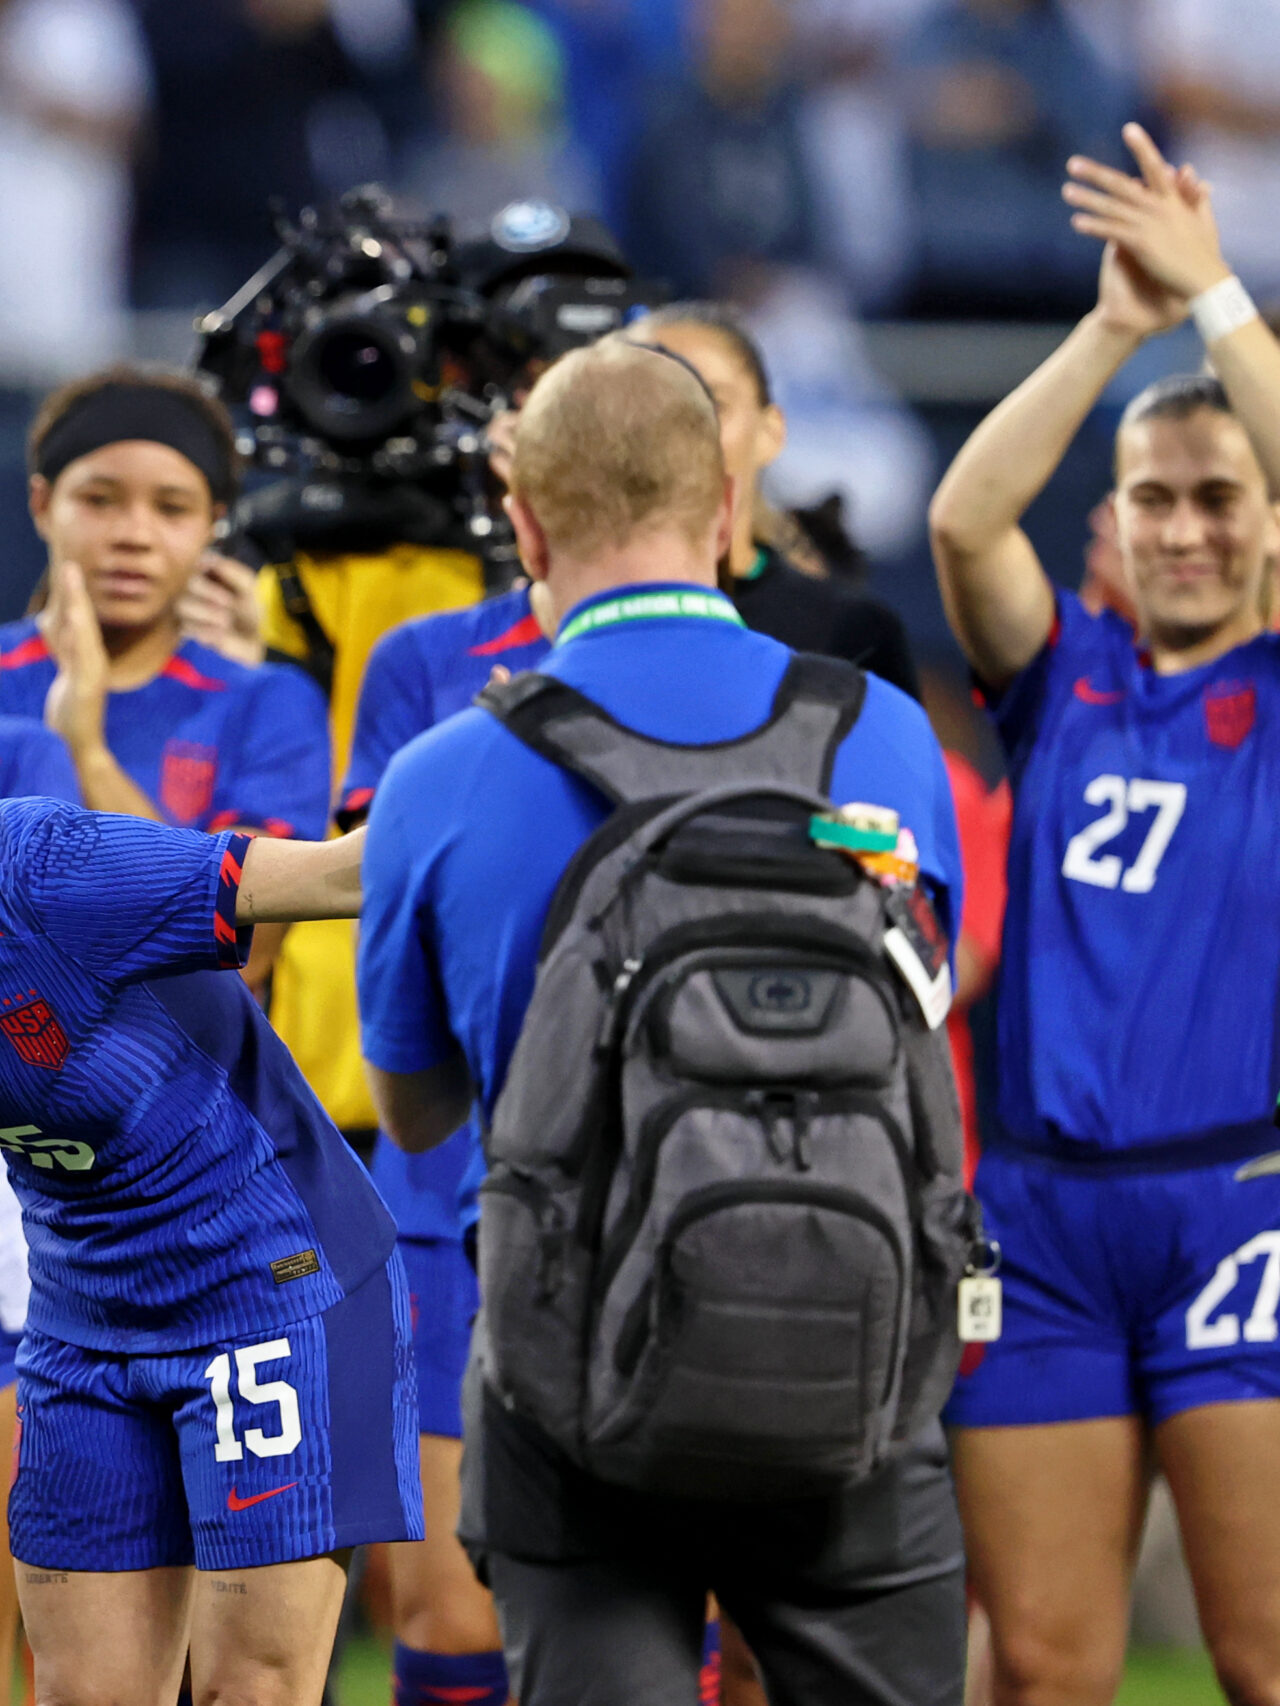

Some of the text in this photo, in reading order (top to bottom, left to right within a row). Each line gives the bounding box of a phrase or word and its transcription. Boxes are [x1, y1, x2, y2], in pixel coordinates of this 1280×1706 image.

[1062, 774, 1187, 893] 27
[1, 1003, 51, 1034] USA
[1185, 1230, 1280, 1351] 27
[204, 1337, 302, 1462] 15
